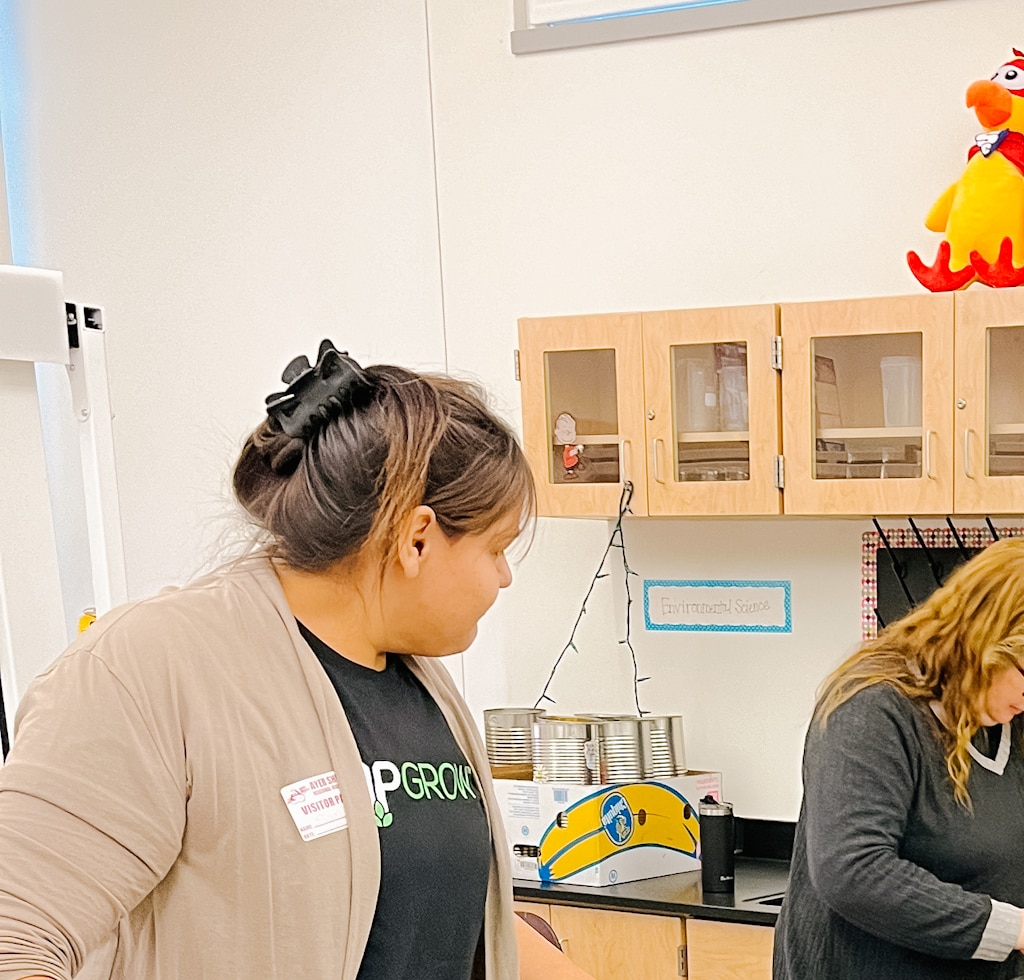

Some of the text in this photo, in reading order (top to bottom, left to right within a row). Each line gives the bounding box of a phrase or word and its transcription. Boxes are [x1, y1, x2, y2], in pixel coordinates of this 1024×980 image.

[735, 599, 771, 613] Science
[309, 777, 327, 790] AYER
[300, 796, 336, 816] VISITOR
